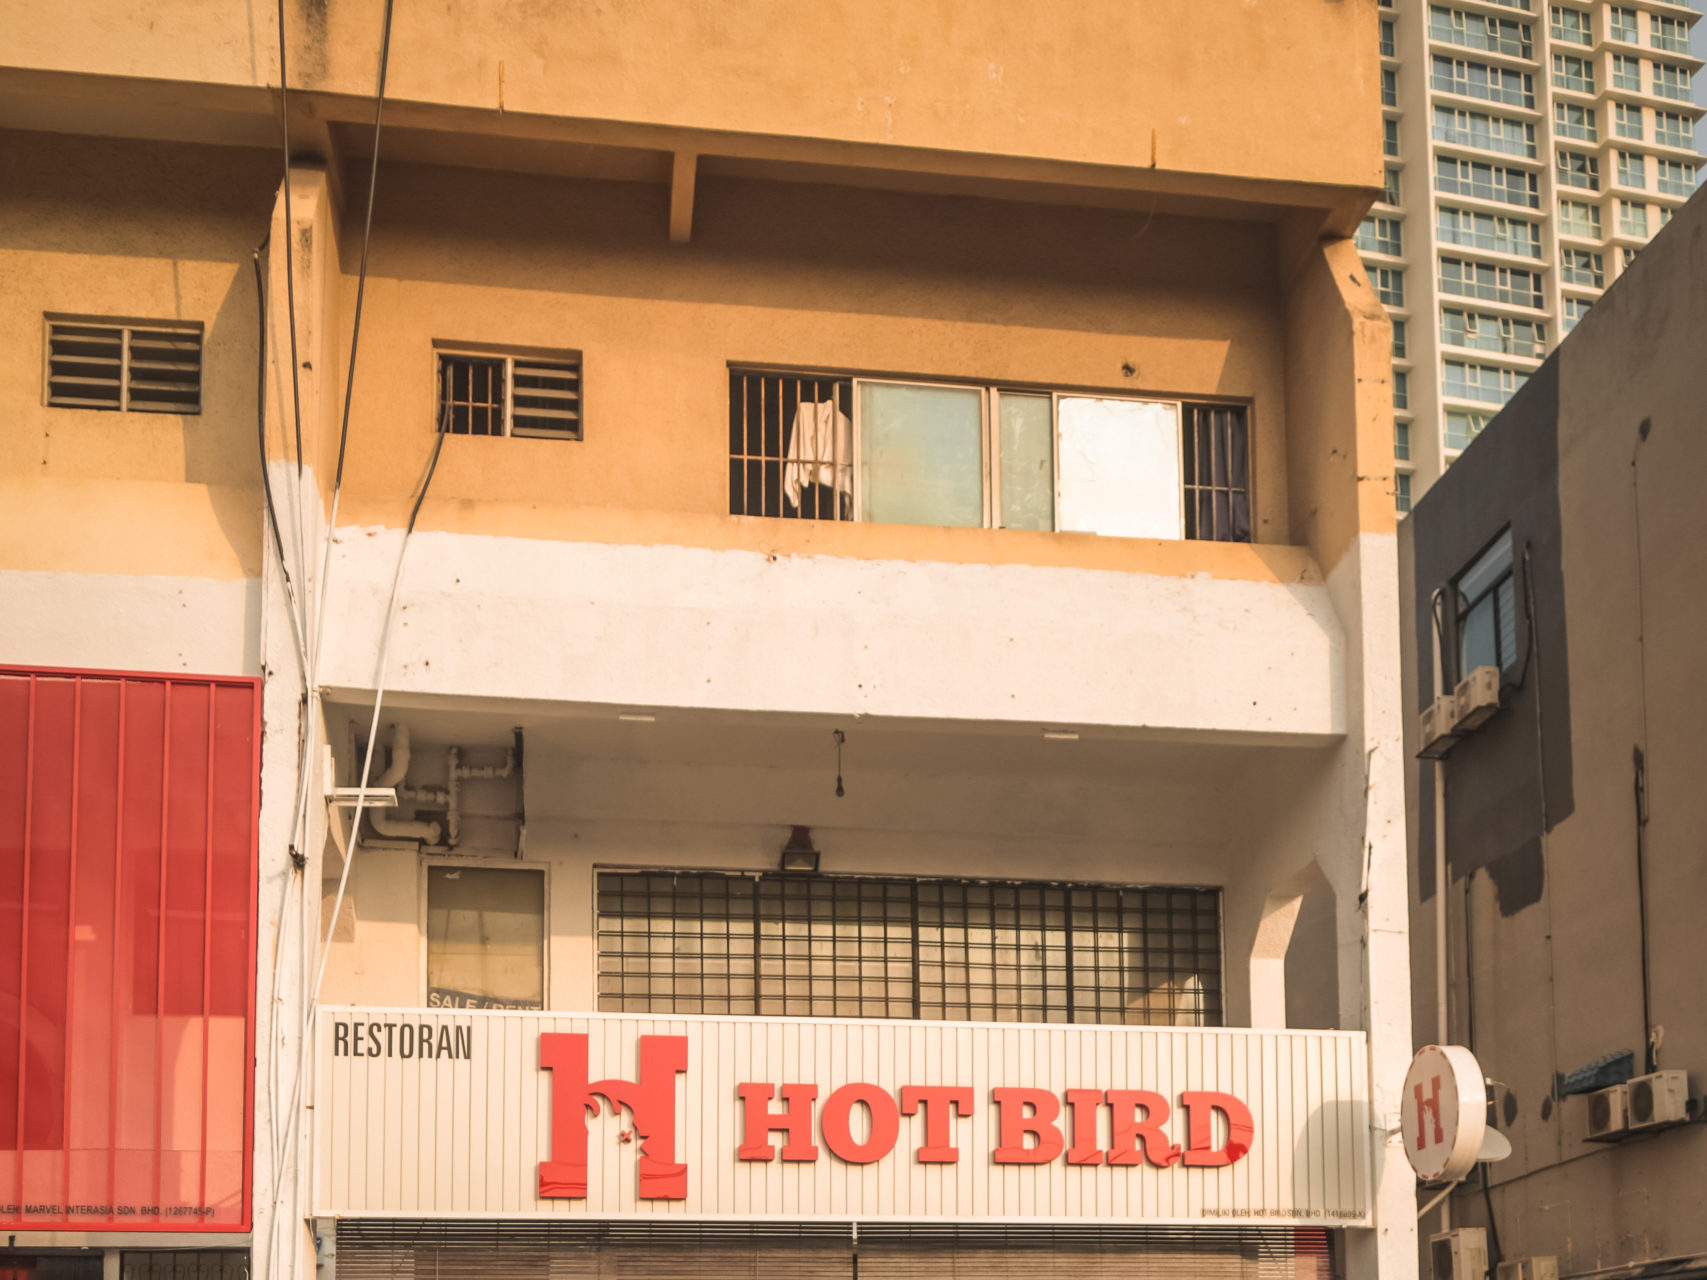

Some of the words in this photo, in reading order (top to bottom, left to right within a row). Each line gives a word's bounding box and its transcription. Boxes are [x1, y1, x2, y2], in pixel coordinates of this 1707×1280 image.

[334, 1022, 472, 1059] RESTORAN
[738, 1082, 975, 1164] HOT
[993, 1087, 1254, 1167] BIRD
[1414, 1075, 1443, 1150] H
[25, 1204, 63, 1214] MARVEL
[65, 1205, 114, 1215] INTERASIA
